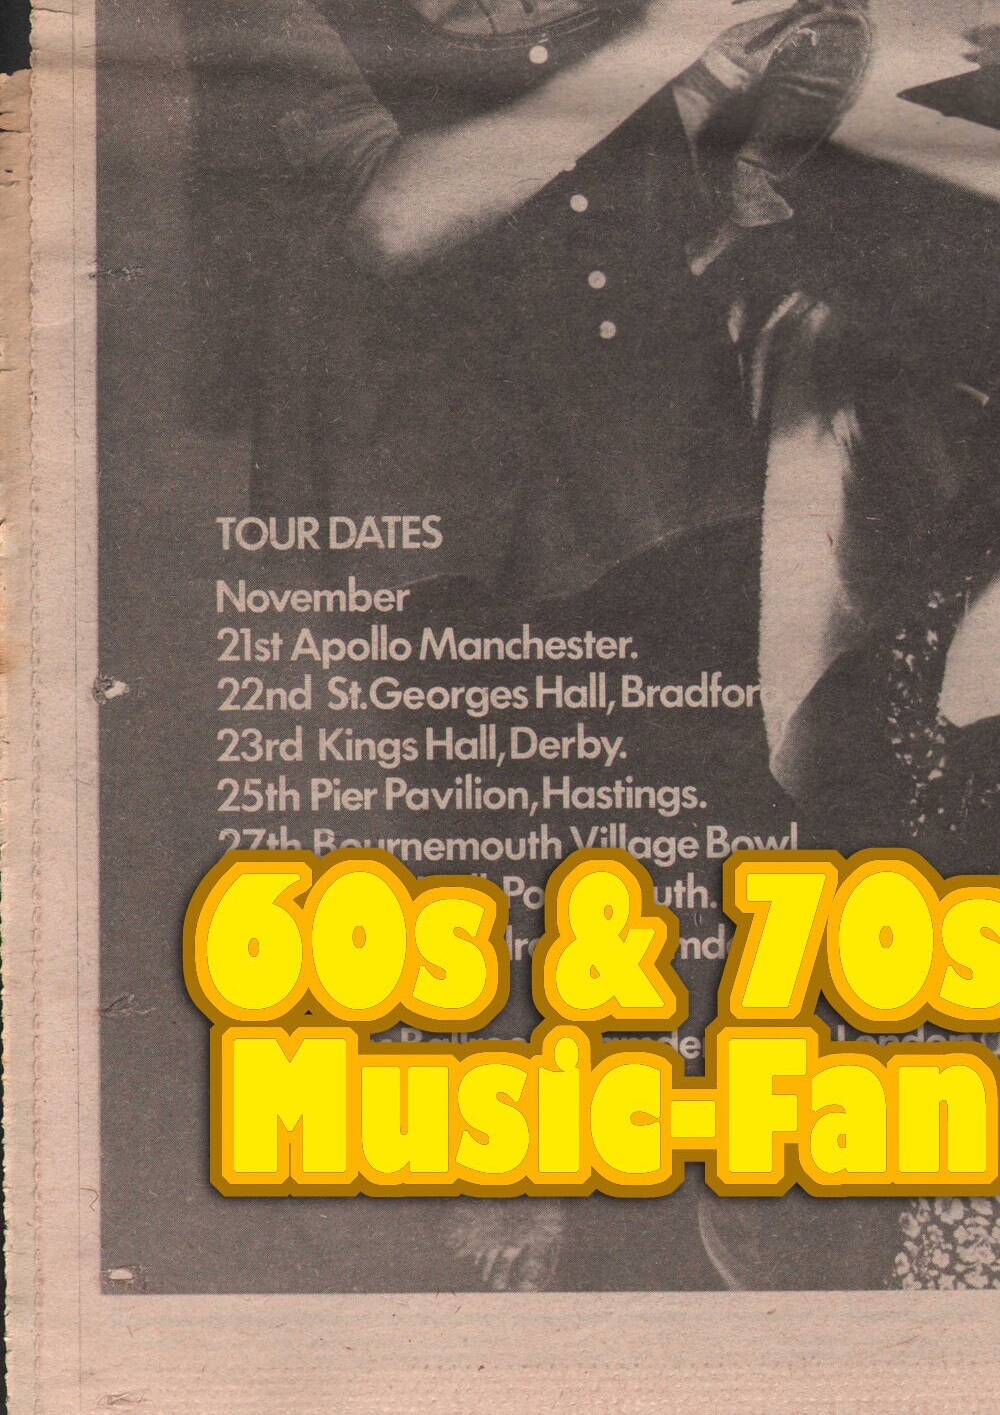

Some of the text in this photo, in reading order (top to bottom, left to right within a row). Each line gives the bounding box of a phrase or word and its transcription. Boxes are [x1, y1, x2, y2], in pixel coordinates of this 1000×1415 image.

[216, 515, 443, 551] TOUR DATES
[216, 576, 410, 613] November
[217, 623, 639, 669] 21st Apollo Manchester.
[217, 674, 312, 712] 22nd
[217, 725, 303, 762] 23rd
[318, 726, 418, 769] Kings
[217, 775, 300, 813] 25th
[310, 776, 378, 812] Pier
[218, 826, 301, 851] 27th
[569, 822, 700, 867] Village
[706, 821, 798, 859] Bowl
